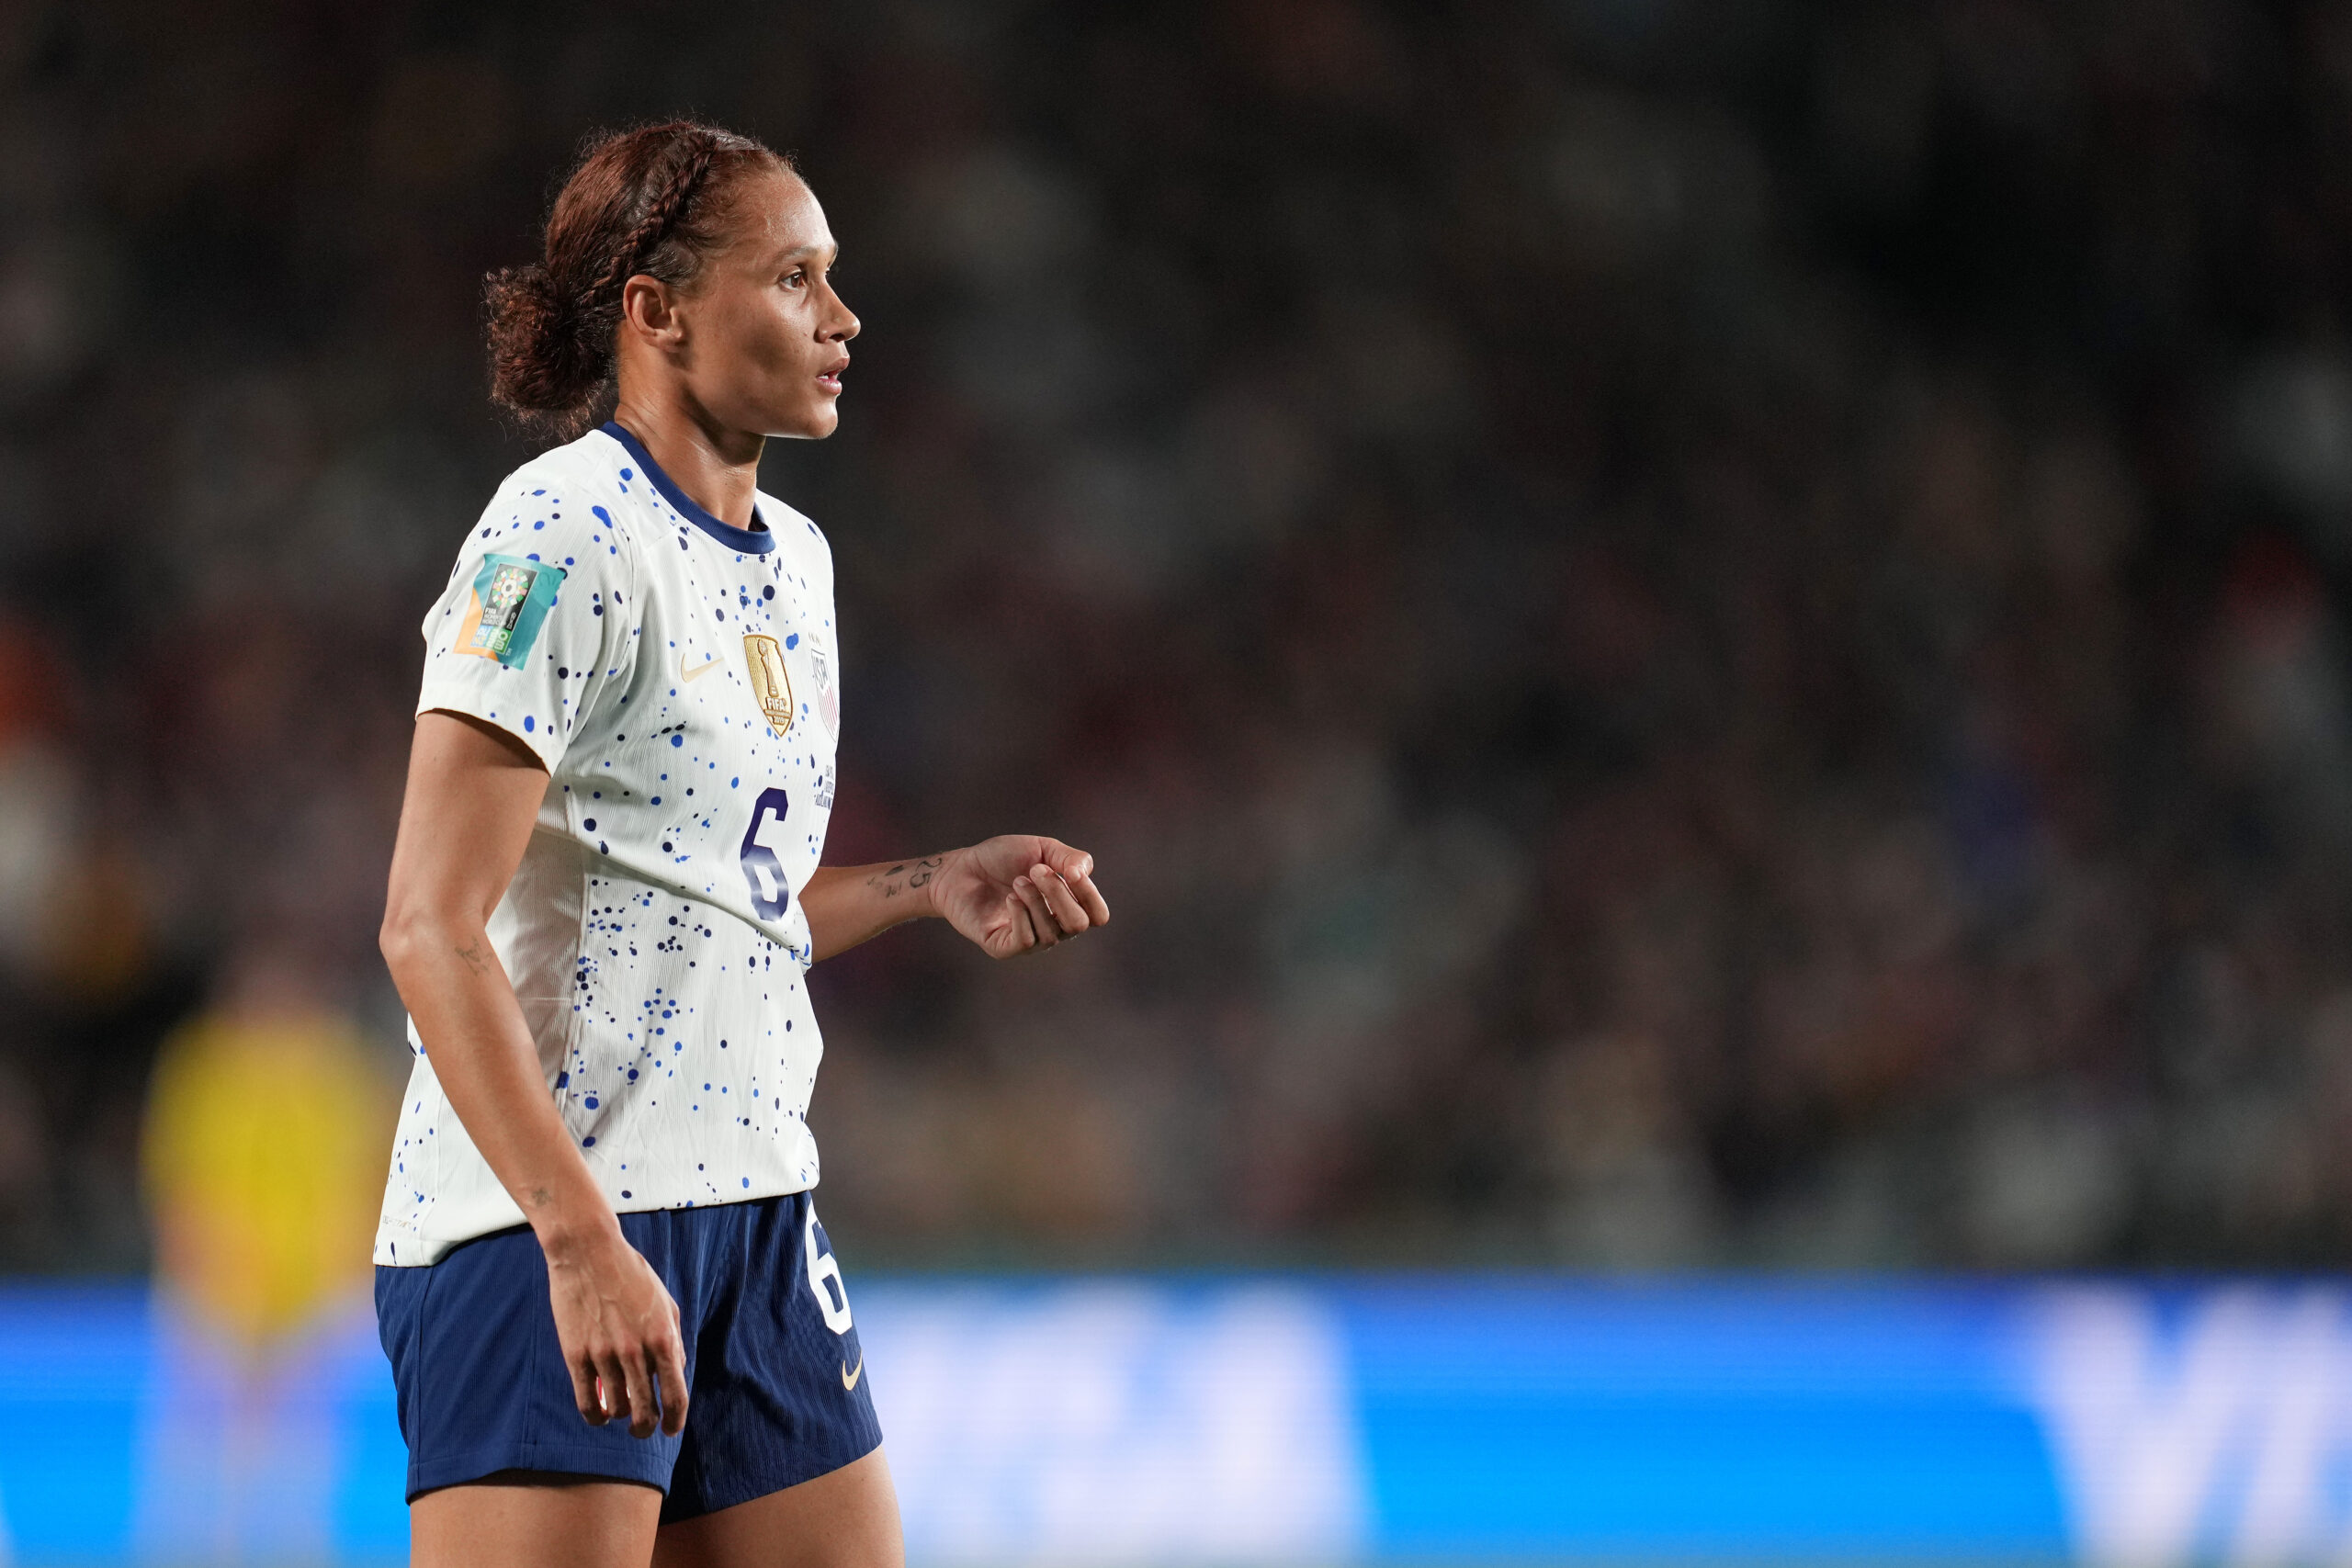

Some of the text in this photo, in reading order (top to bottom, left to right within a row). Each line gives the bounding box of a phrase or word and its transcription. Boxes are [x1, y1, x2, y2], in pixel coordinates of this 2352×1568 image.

[766, 697, 786, 711] FIFA
[741, 787, 789, 922] 6
[805, 1198, 853, 1336] 6
